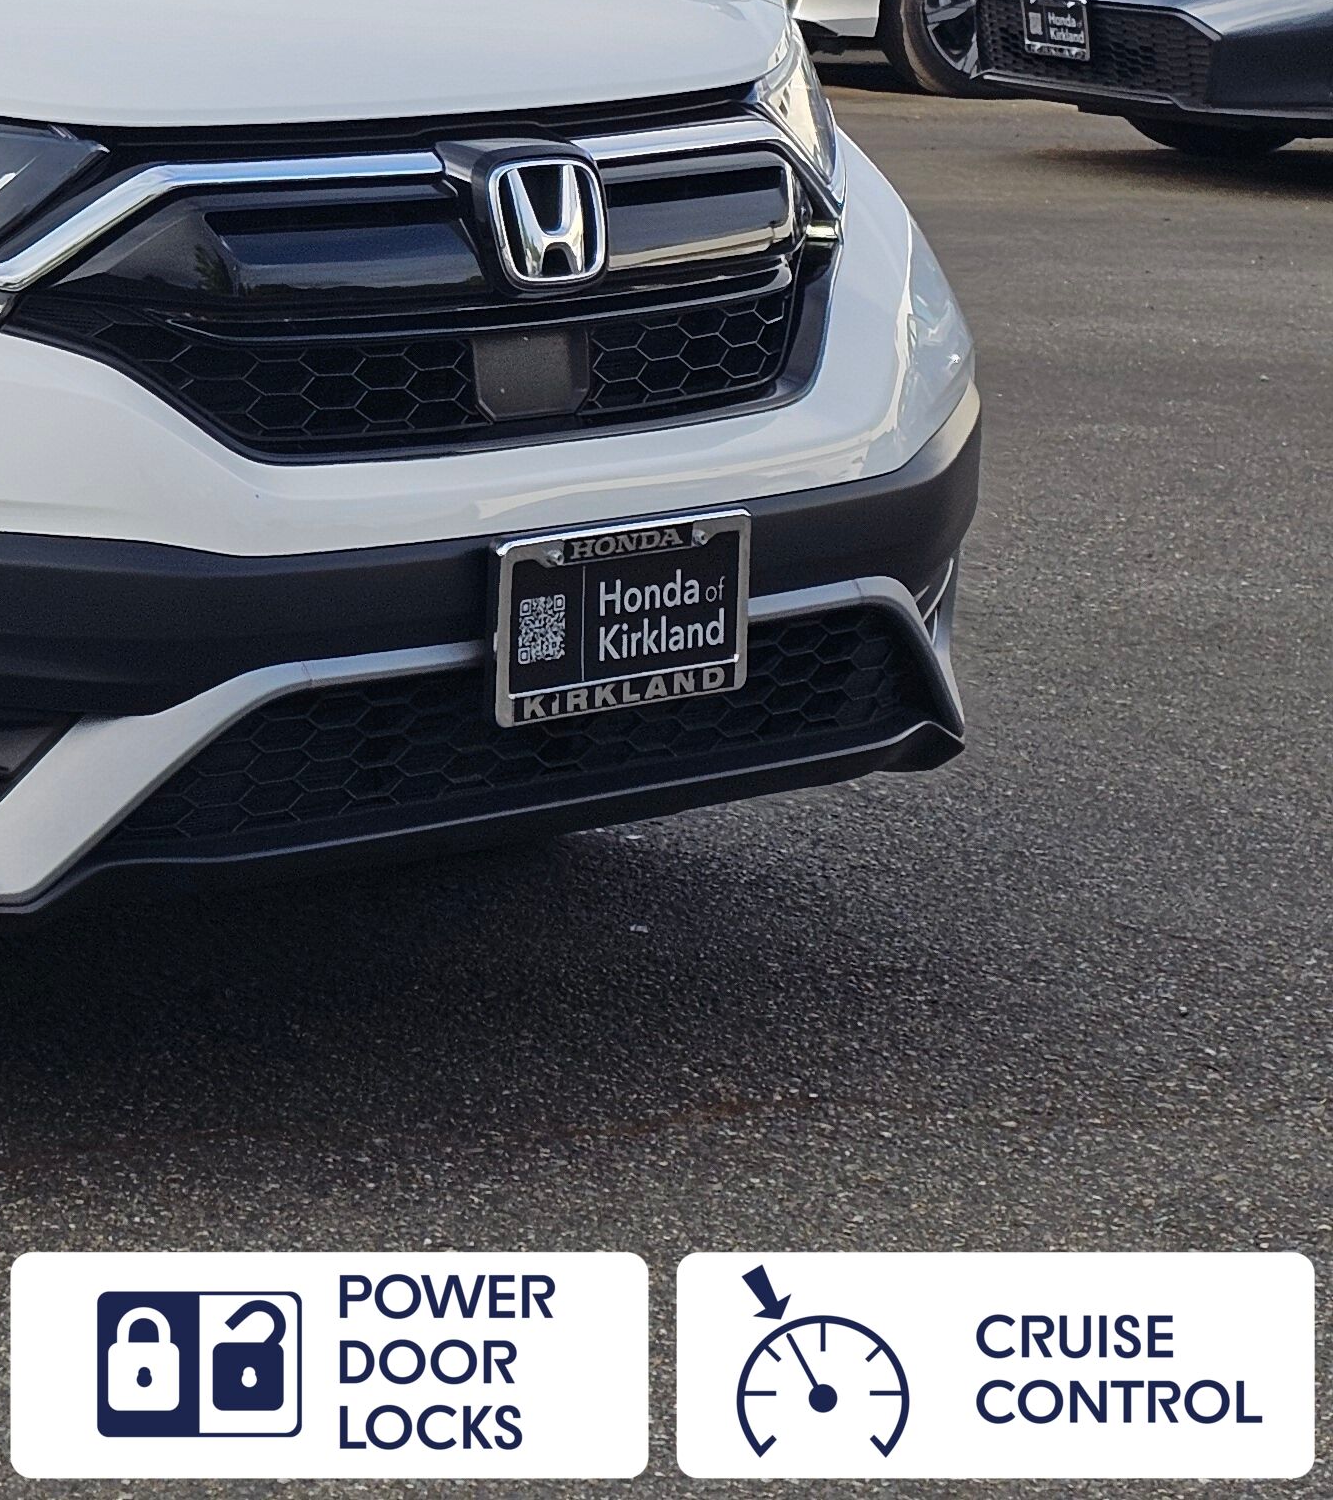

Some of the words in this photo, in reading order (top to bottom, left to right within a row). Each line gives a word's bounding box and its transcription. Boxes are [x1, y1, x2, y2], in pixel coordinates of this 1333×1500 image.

[569, 528, 684, 561] HONDA
[598, 568, 701, 617] Honda
[705, 575, 726, 603] of
[598, 607, 726, 663] Kirkland
[522, 666, 727, 720] KIRKLAND
